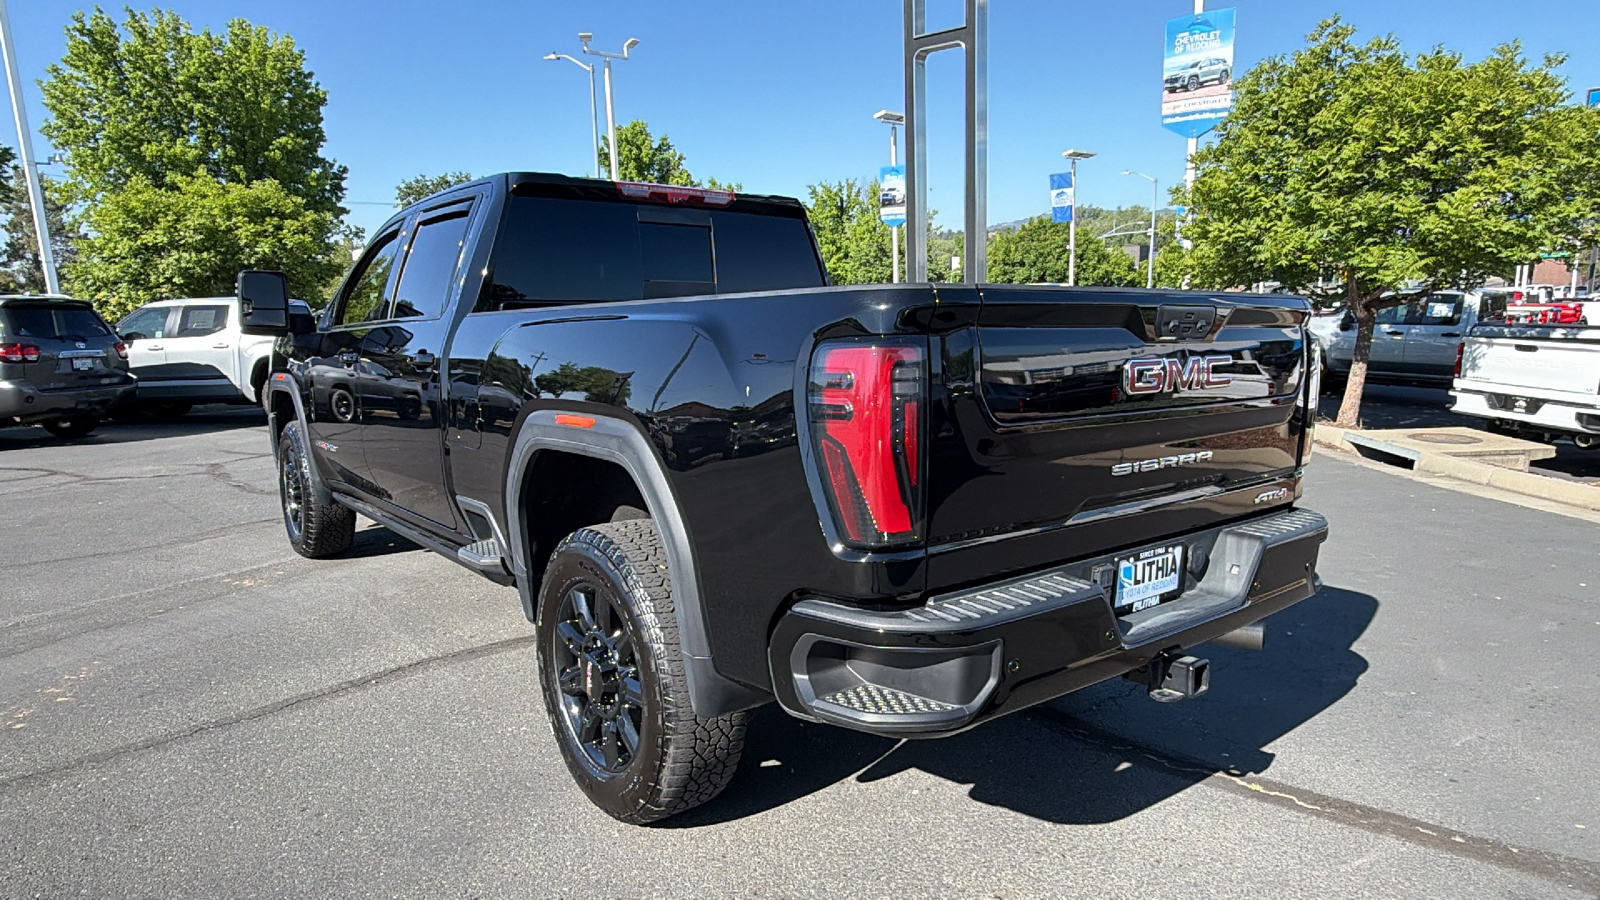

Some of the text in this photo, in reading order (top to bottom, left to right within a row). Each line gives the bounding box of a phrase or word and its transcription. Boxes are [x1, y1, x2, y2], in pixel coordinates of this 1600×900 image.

[1175, 30, 1220, 46] CHEVROLET
[1175, 39, 1220, 54] OF REDDING
[1123, 354, 1232, 395] GMC
[1111, 450, 1213, 477] SIERRA
[1133, 554, 1177, 586] LITHIA
[1141, 584, 1151, 594] OF
[1151, 576, 1177, 591] REDDING
